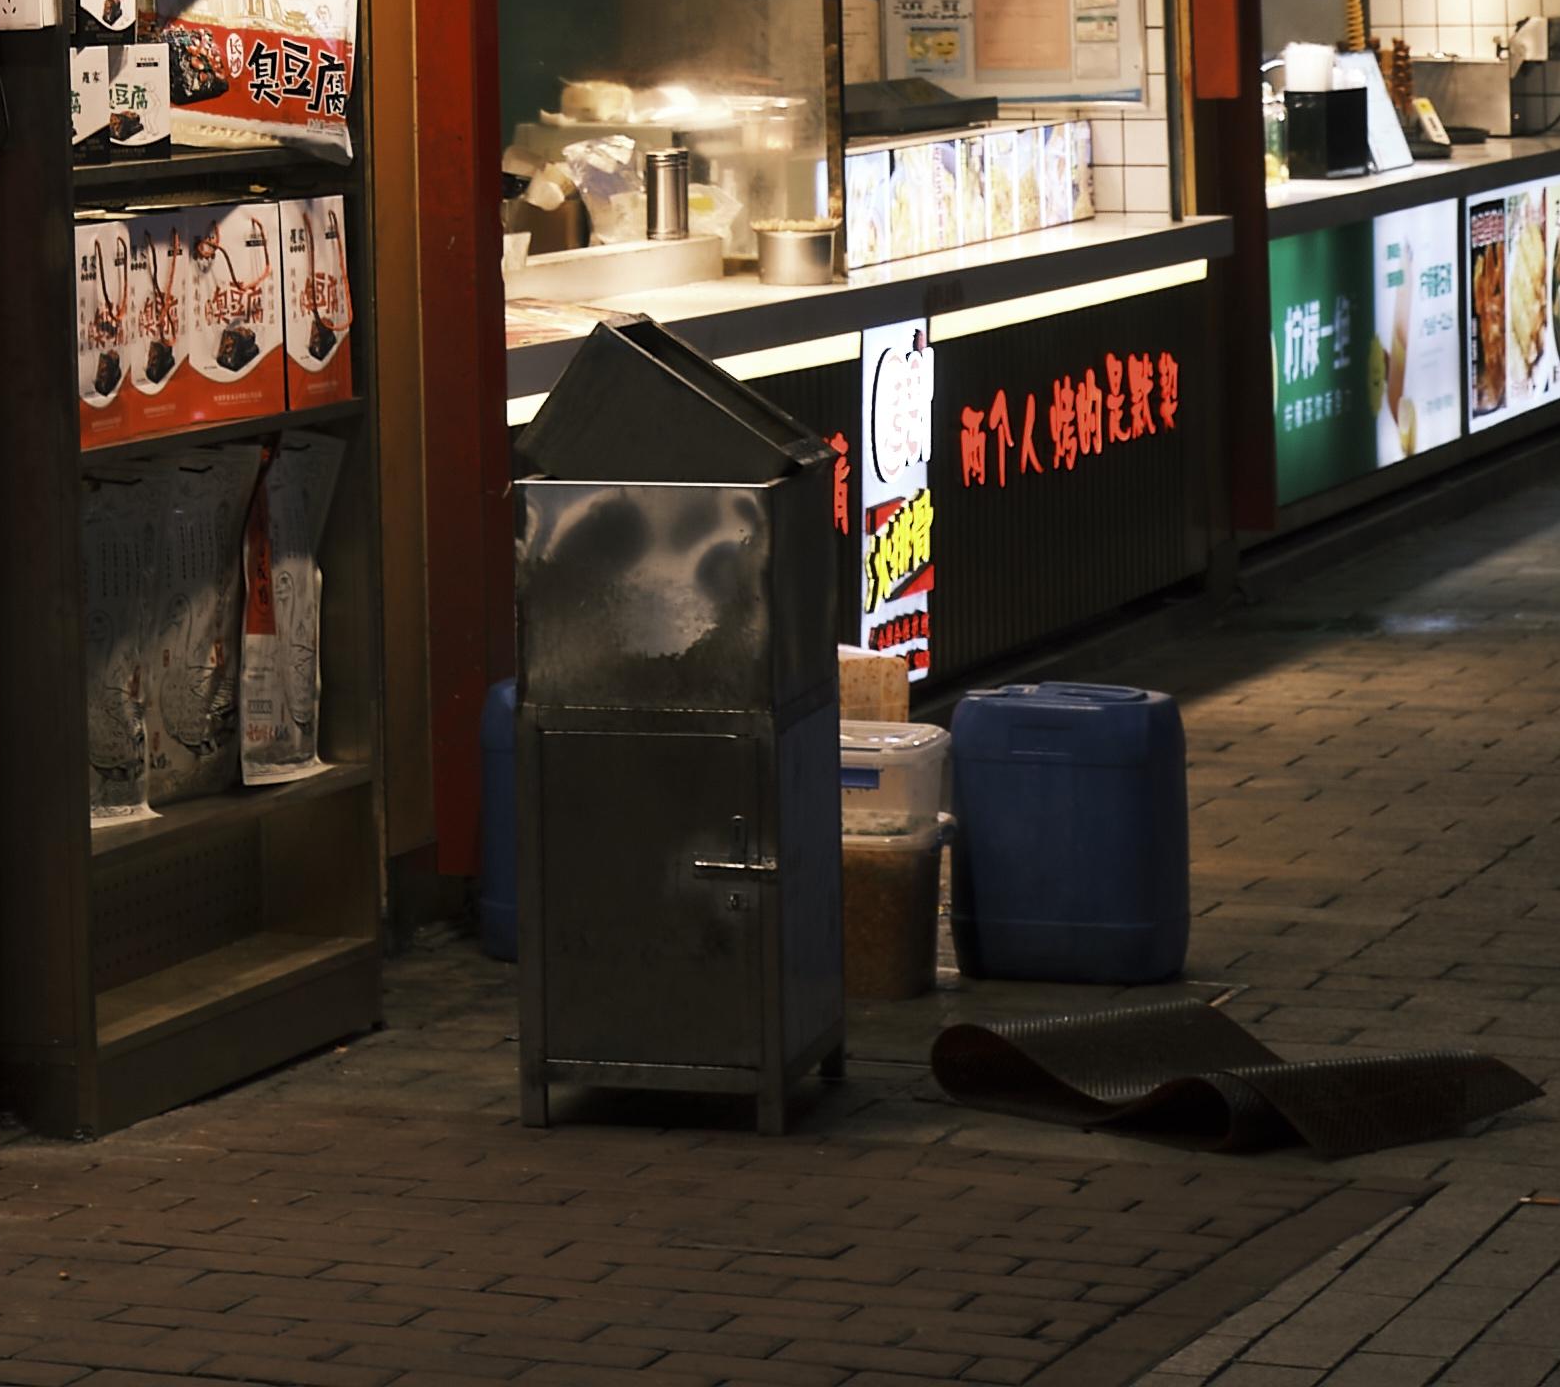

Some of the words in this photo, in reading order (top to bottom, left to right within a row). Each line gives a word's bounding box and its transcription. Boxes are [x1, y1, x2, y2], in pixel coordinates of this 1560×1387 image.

[108, 83, 149, 110] 豆腐
[228, 35, 244, 75] 长沙
[247, 38, 349, 119] 臭豆腐
[959, 351, 1181, 490] 两个人烤的是默契
